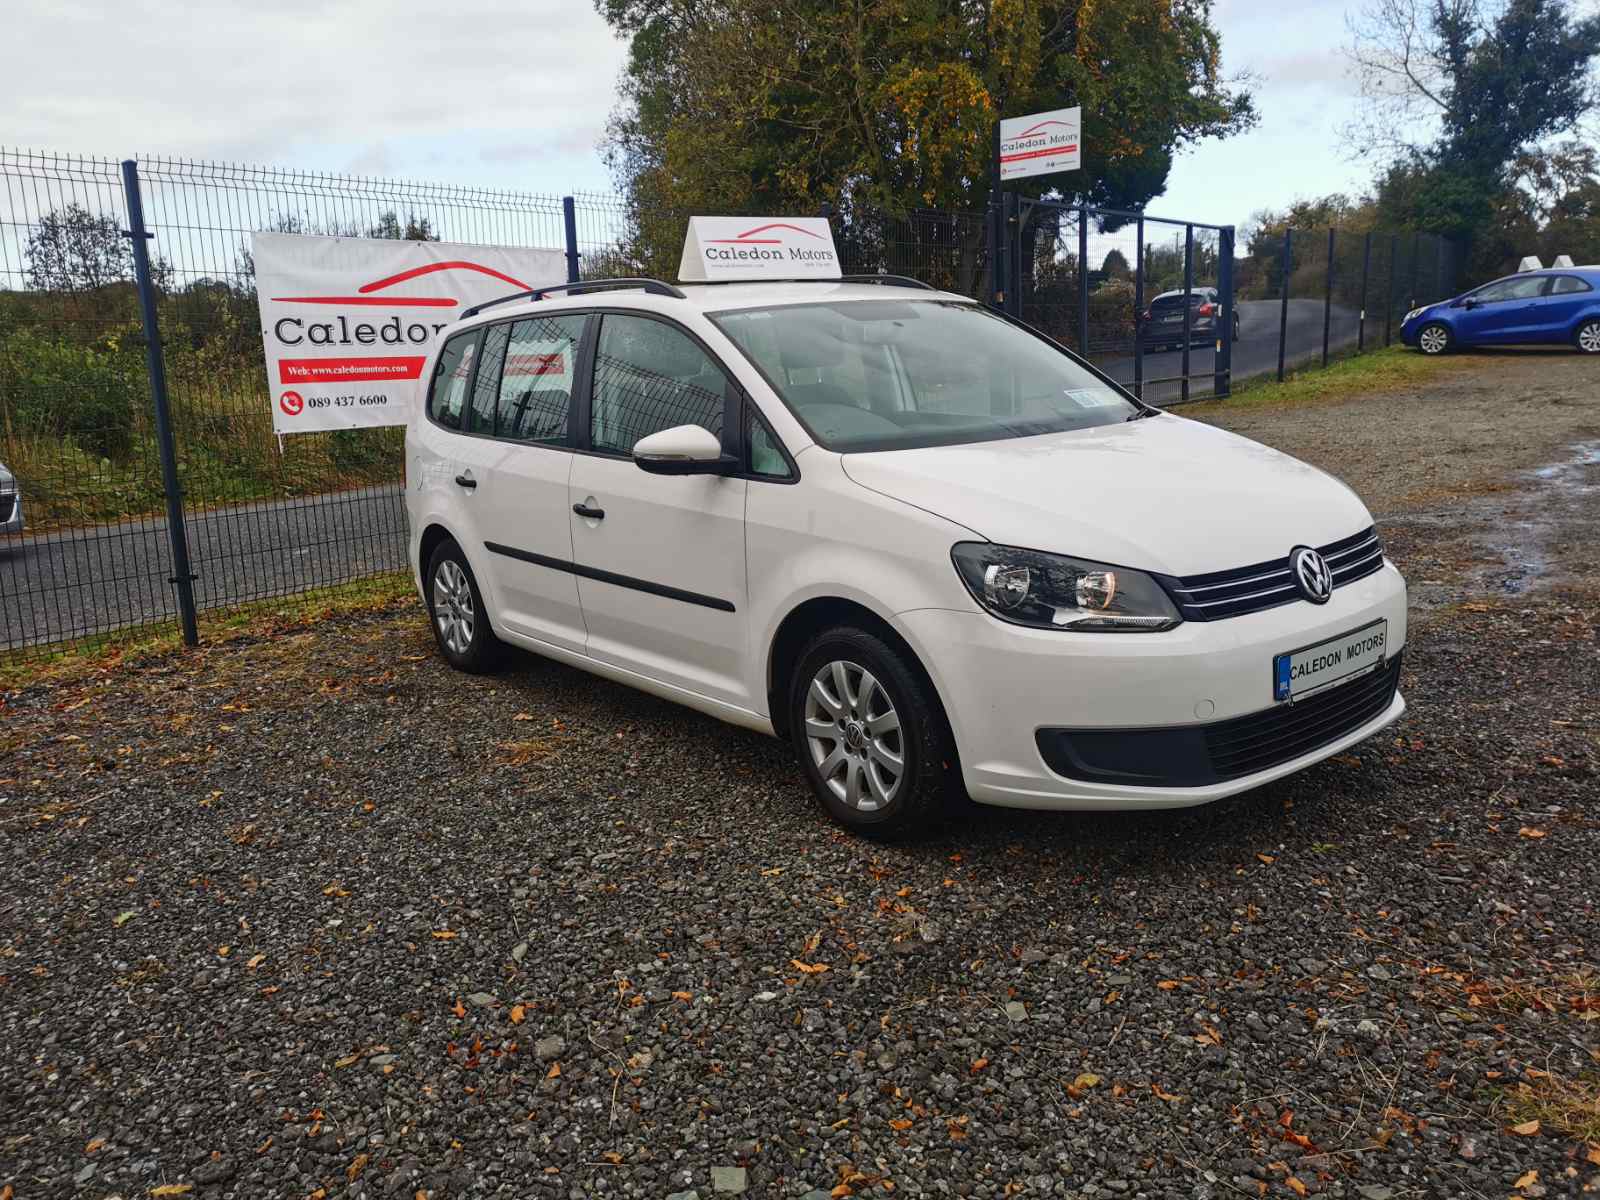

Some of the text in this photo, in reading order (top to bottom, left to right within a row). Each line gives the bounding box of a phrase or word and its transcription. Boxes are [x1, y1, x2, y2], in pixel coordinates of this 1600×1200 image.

[1001, 134, 1078, 152] Caledon Motors
[705, 246, 833, 260] Caledon Motors
[288, 364, 408, 376] Web: www.caledonmotors.com
[308, 395, 387, 408] 089 437 6600
[1290, 651, 1342, 680] CALEDON
[1347, 633, 1384, 659] MOTORS
